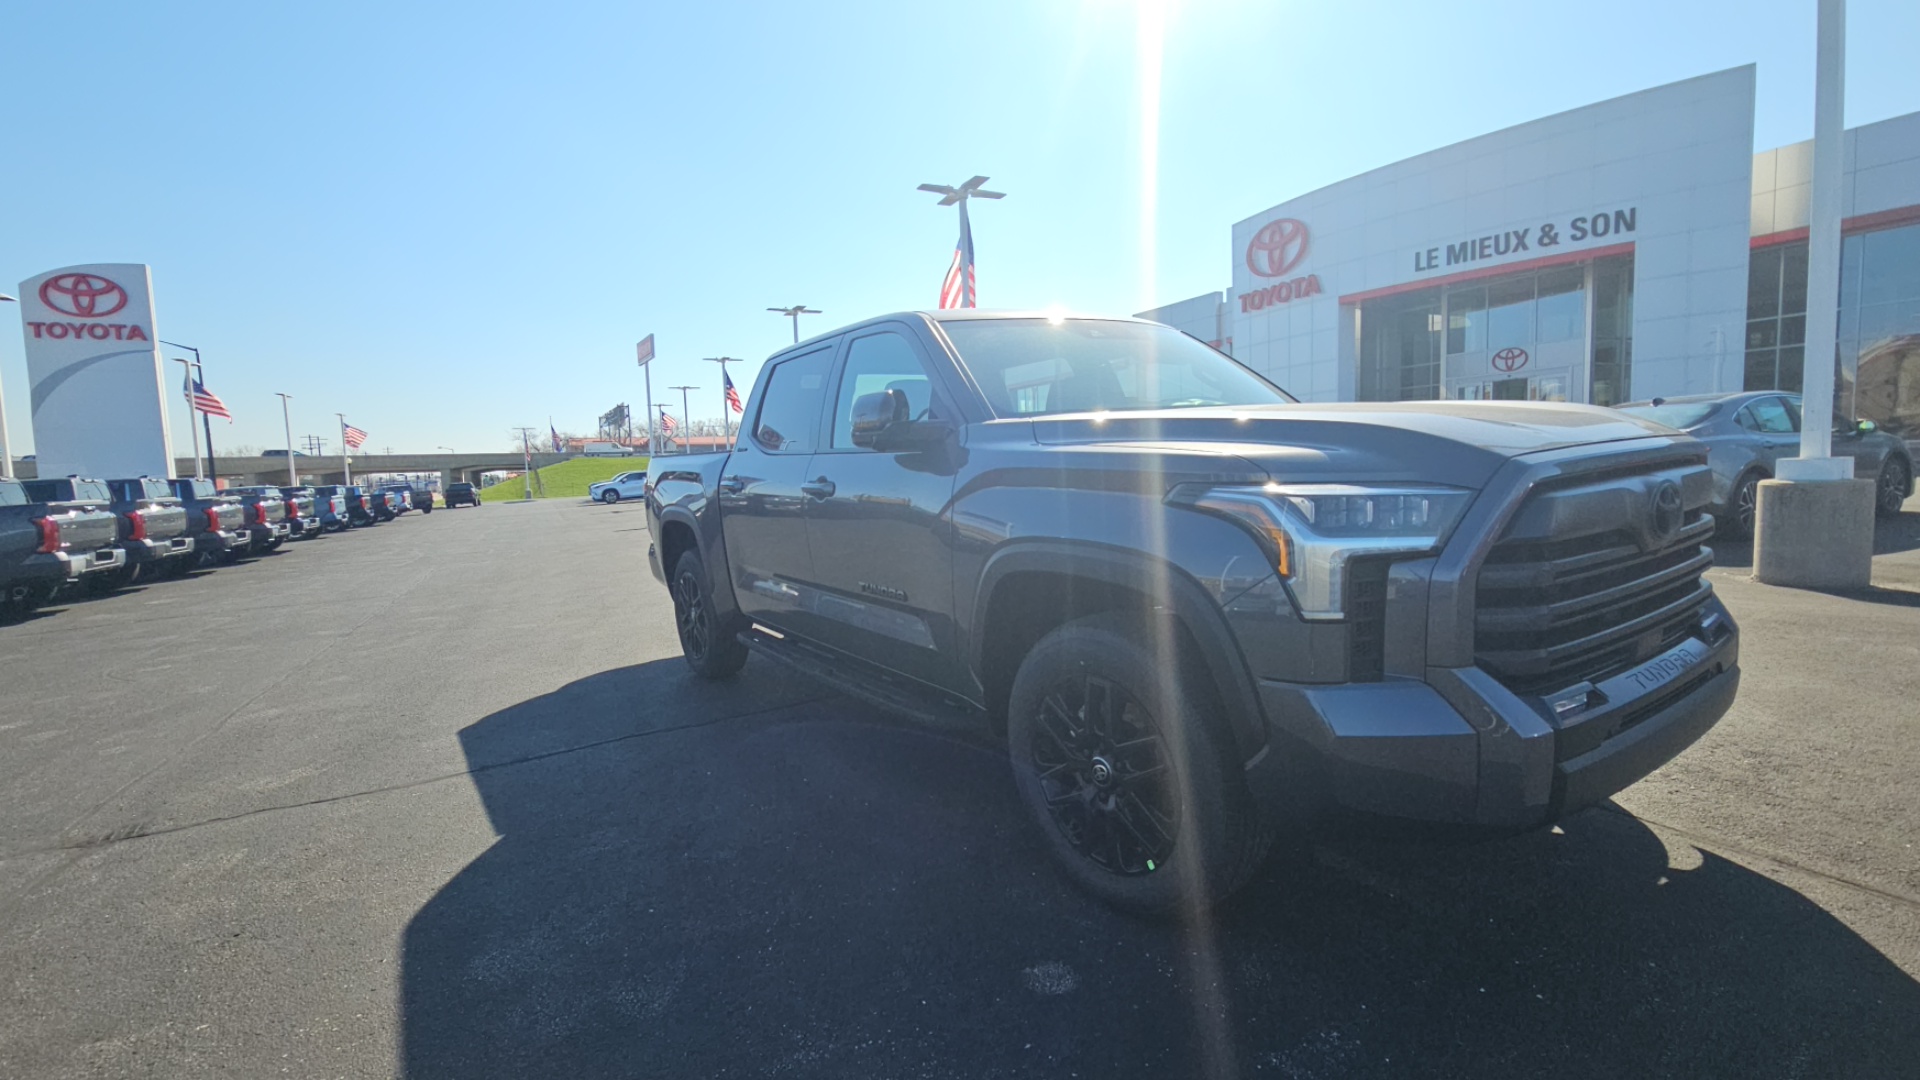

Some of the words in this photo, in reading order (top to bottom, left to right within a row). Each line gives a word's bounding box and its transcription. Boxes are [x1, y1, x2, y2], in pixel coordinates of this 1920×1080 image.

[1414, 247, 1439, 272] LE
[1446, 228, 1530, 266] MIEUX
[1537, 223, 1560, 248] &
[1570, 207, 1637, 241] SON
[1238, 274, 1322, 313] TOYOTA
[27, 322, 148, 341] TOYOTA
[1625, 648, 1698, 689] TUNDRA
